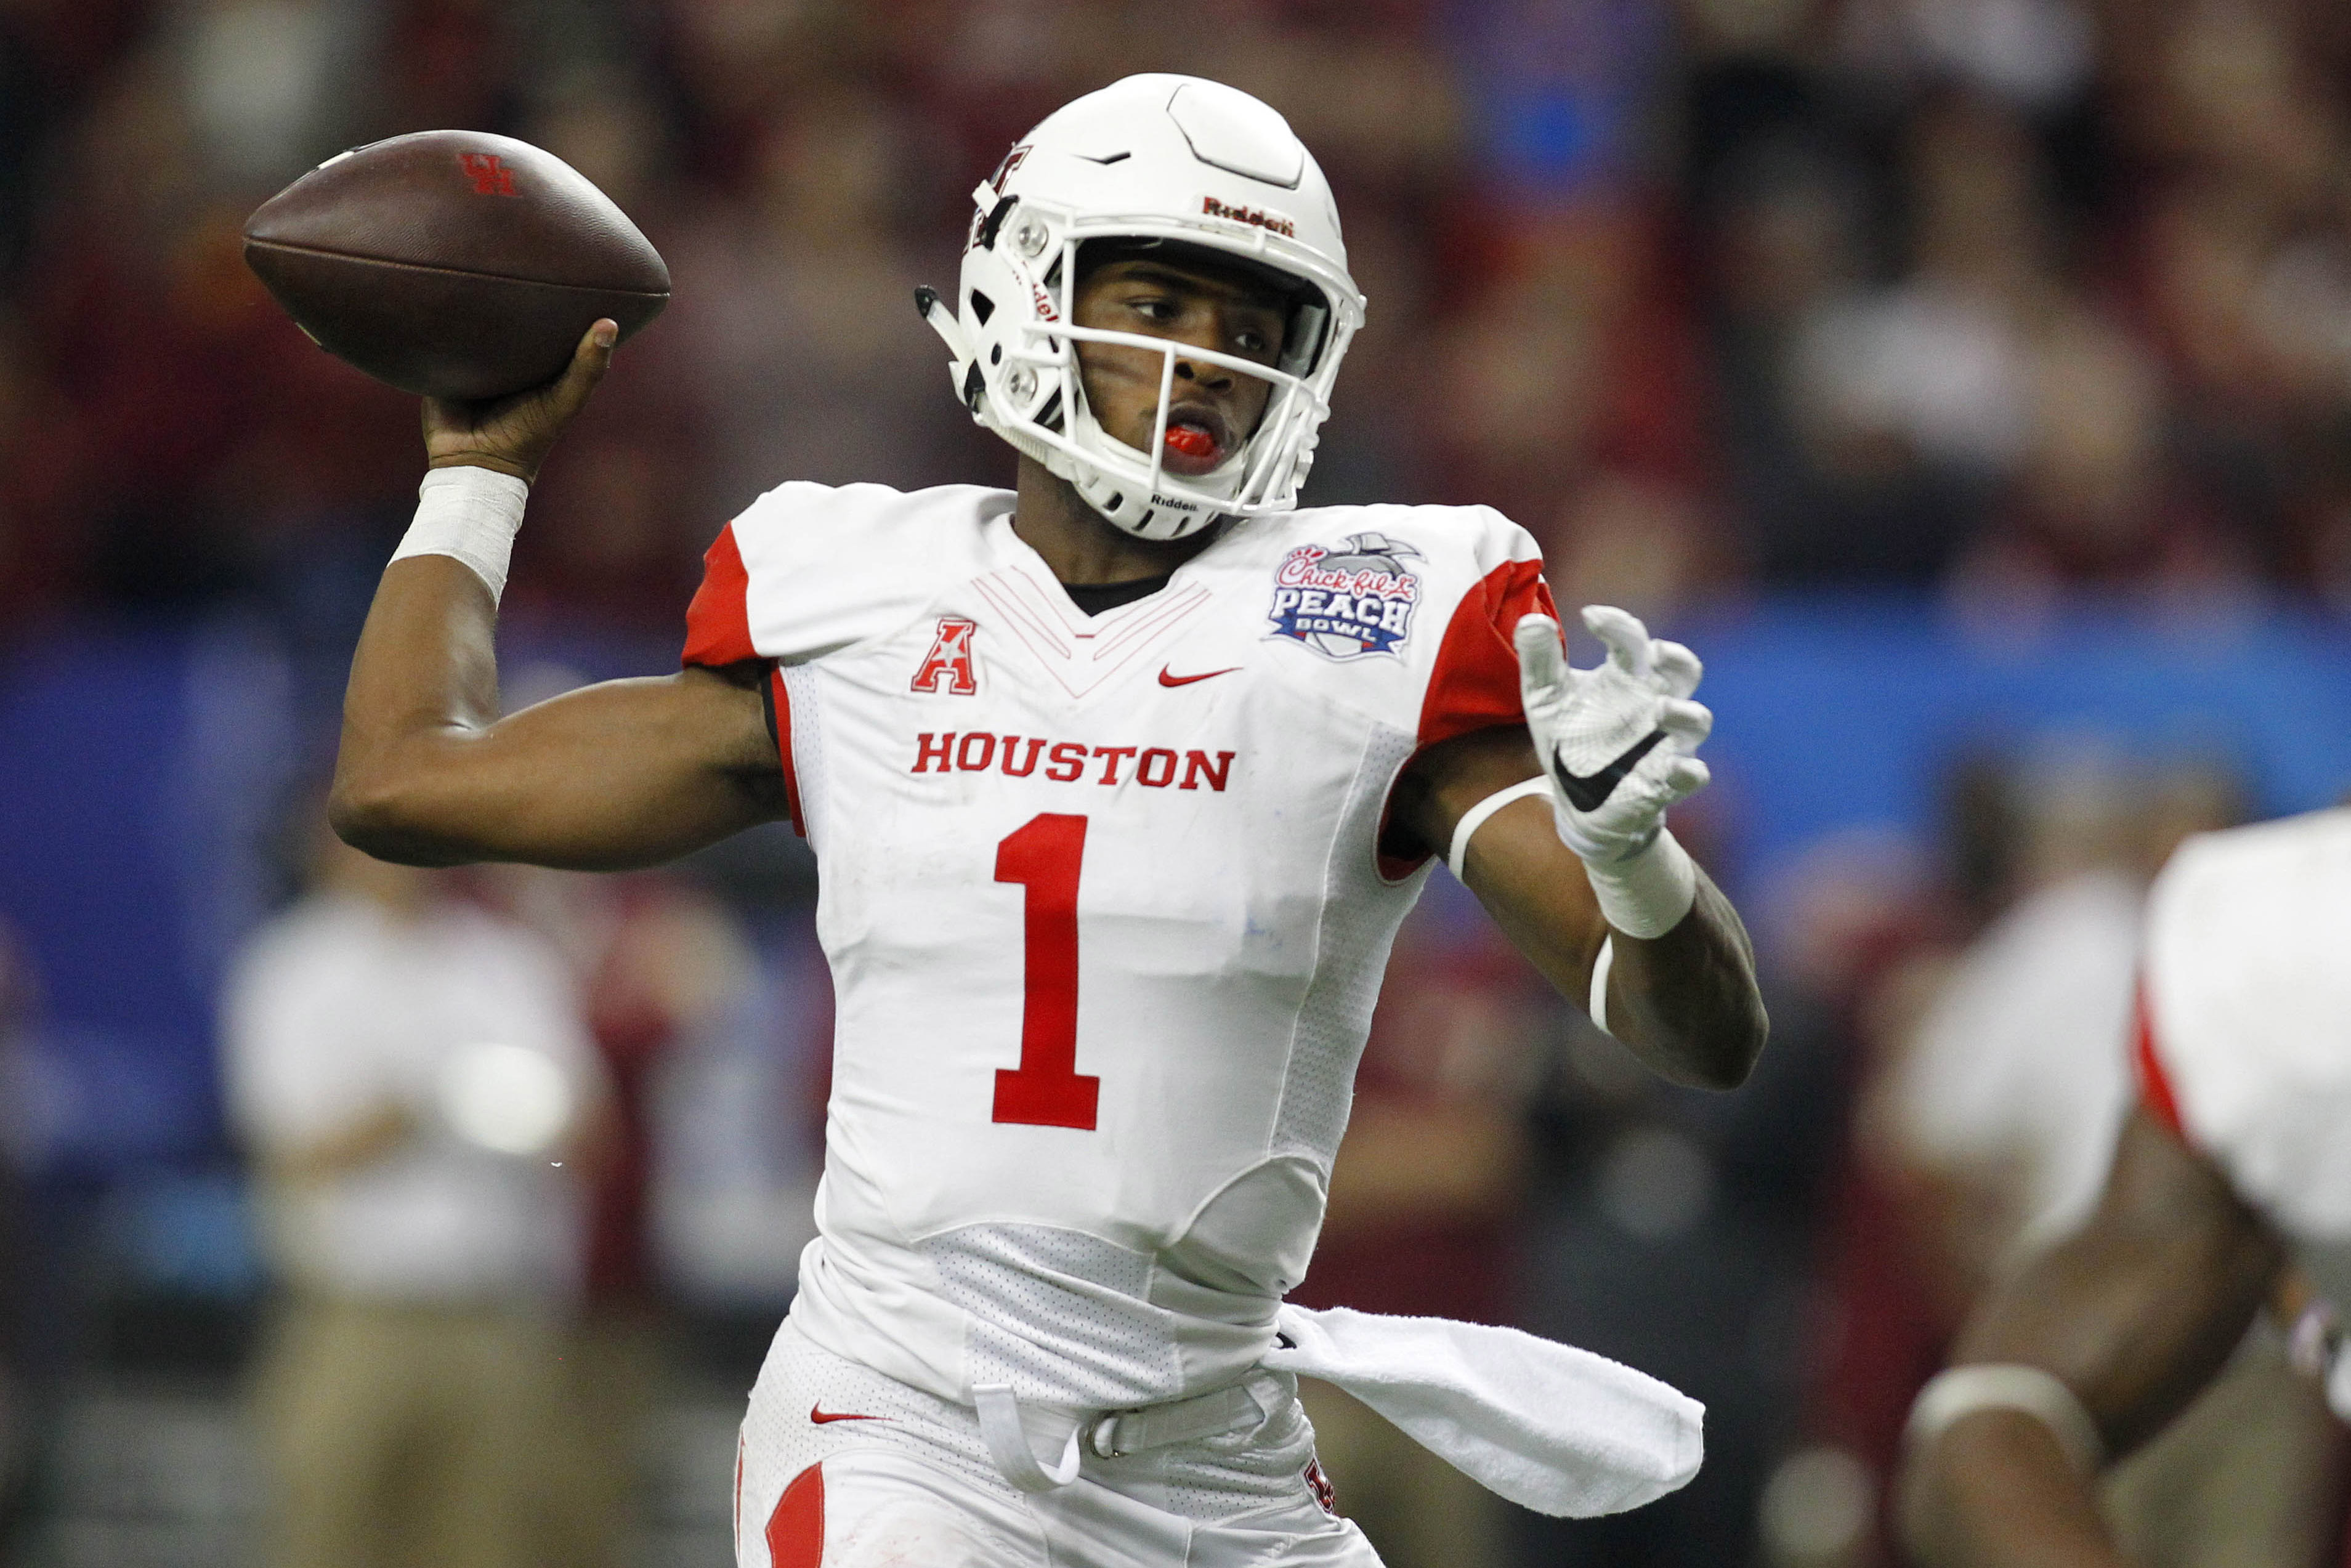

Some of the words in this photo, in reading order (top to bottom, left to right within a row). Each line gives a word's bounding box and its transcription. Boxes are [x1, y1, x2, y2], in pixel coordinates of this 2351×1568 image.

[1279, 548, 1415, 599] Chick-fil-A
[1269, 589, 1412, 636] PEACH
[1295, 618, 1377, 642] BOWL
[911, 619, 976, 695] A
[911, 732, 1236, 791] HOUSTON
[992, 812, 1100, 1131] 1
